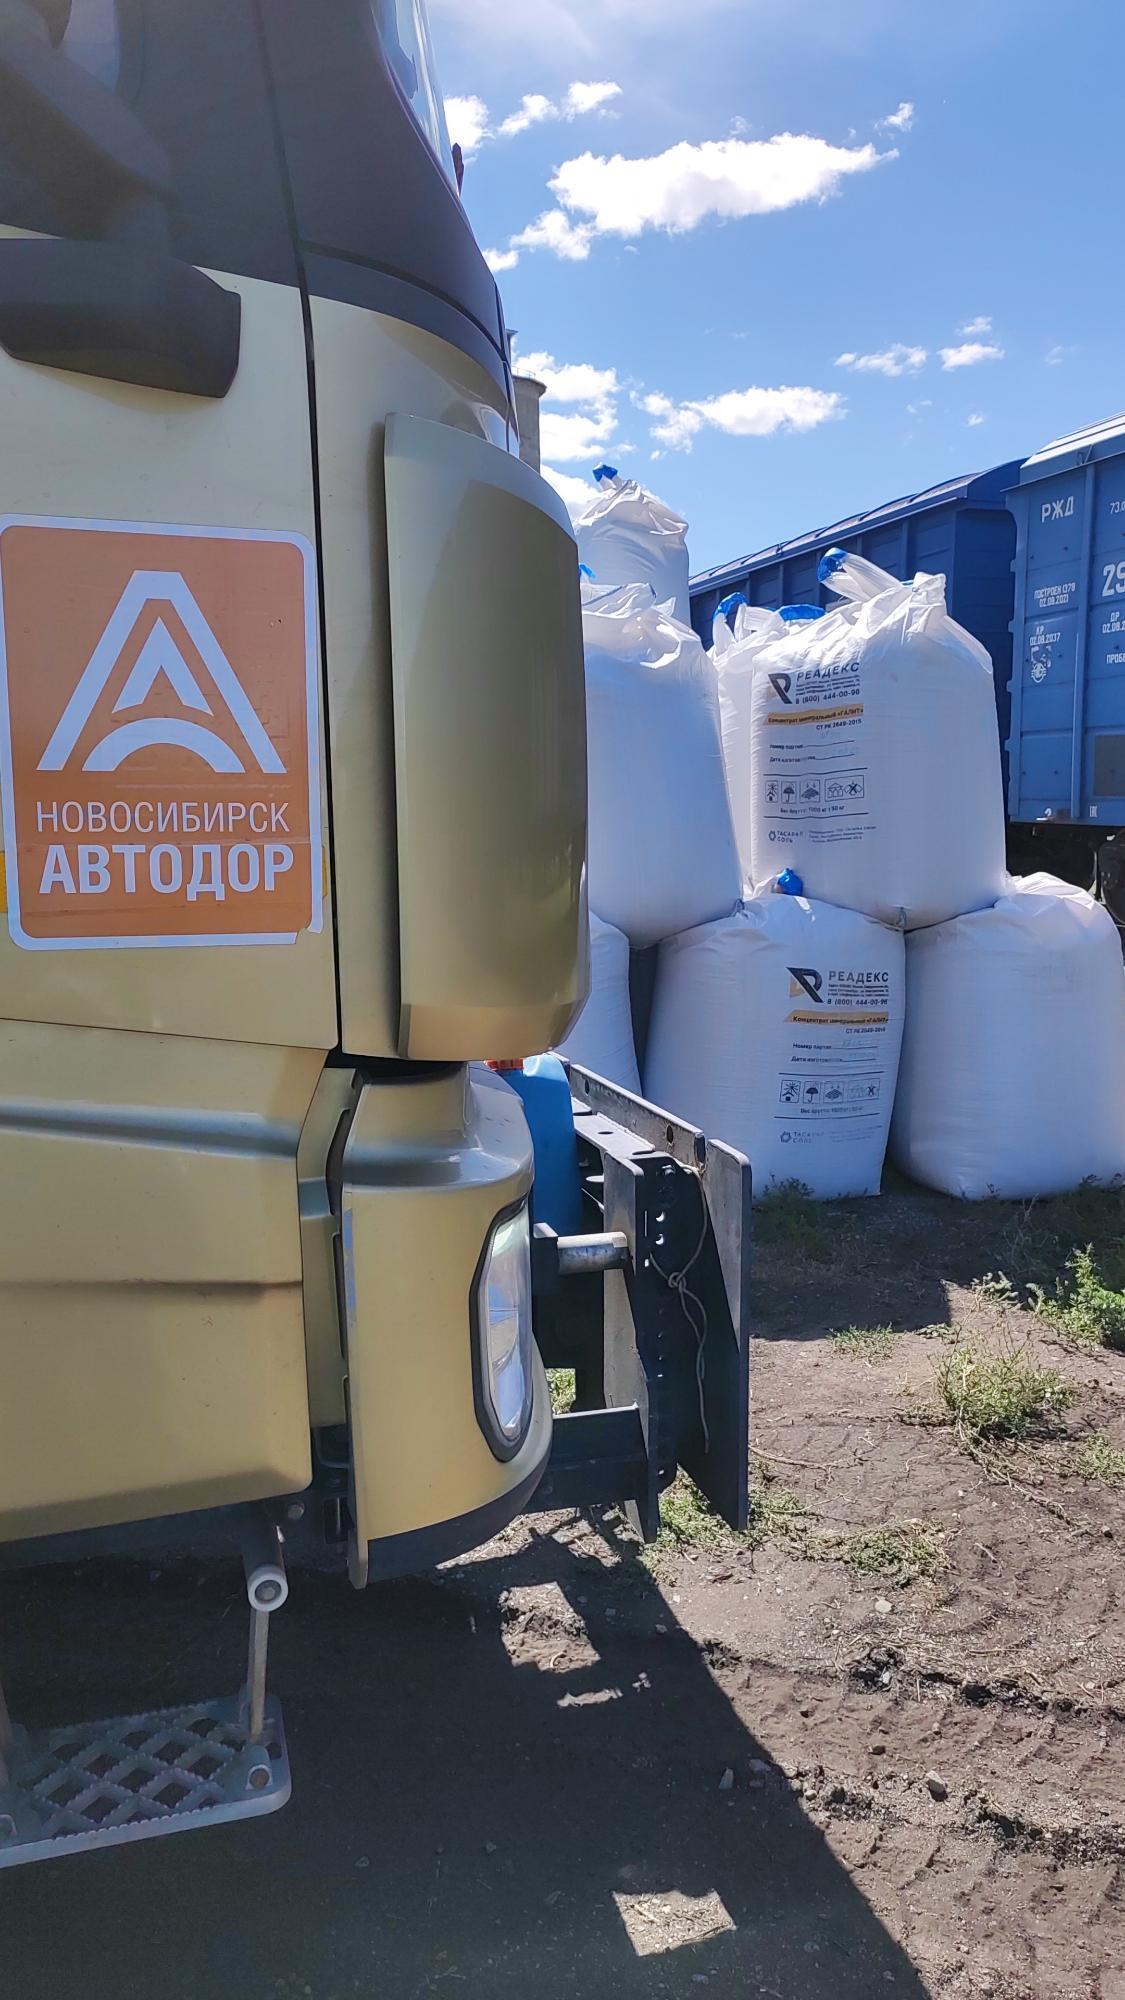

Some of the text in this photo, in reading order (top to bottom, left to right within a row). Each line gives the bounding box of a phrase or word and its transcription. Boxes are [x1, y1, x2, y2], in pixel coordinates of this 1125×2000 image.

[1041, 496, 1075, 523] РЖД
[1034, 585, 1062, 600] ПОСТРОЕН
[796, 662, 860, 681] РЕАДЕКС
[37, 801, 290, 833] НОВОСИБИРСК
[38, 843, 295, 902] АВТОДОР
[828, 970, 889, 985] РЕАДЕКС
[793, 1016, 829, 1024] Концентрат
